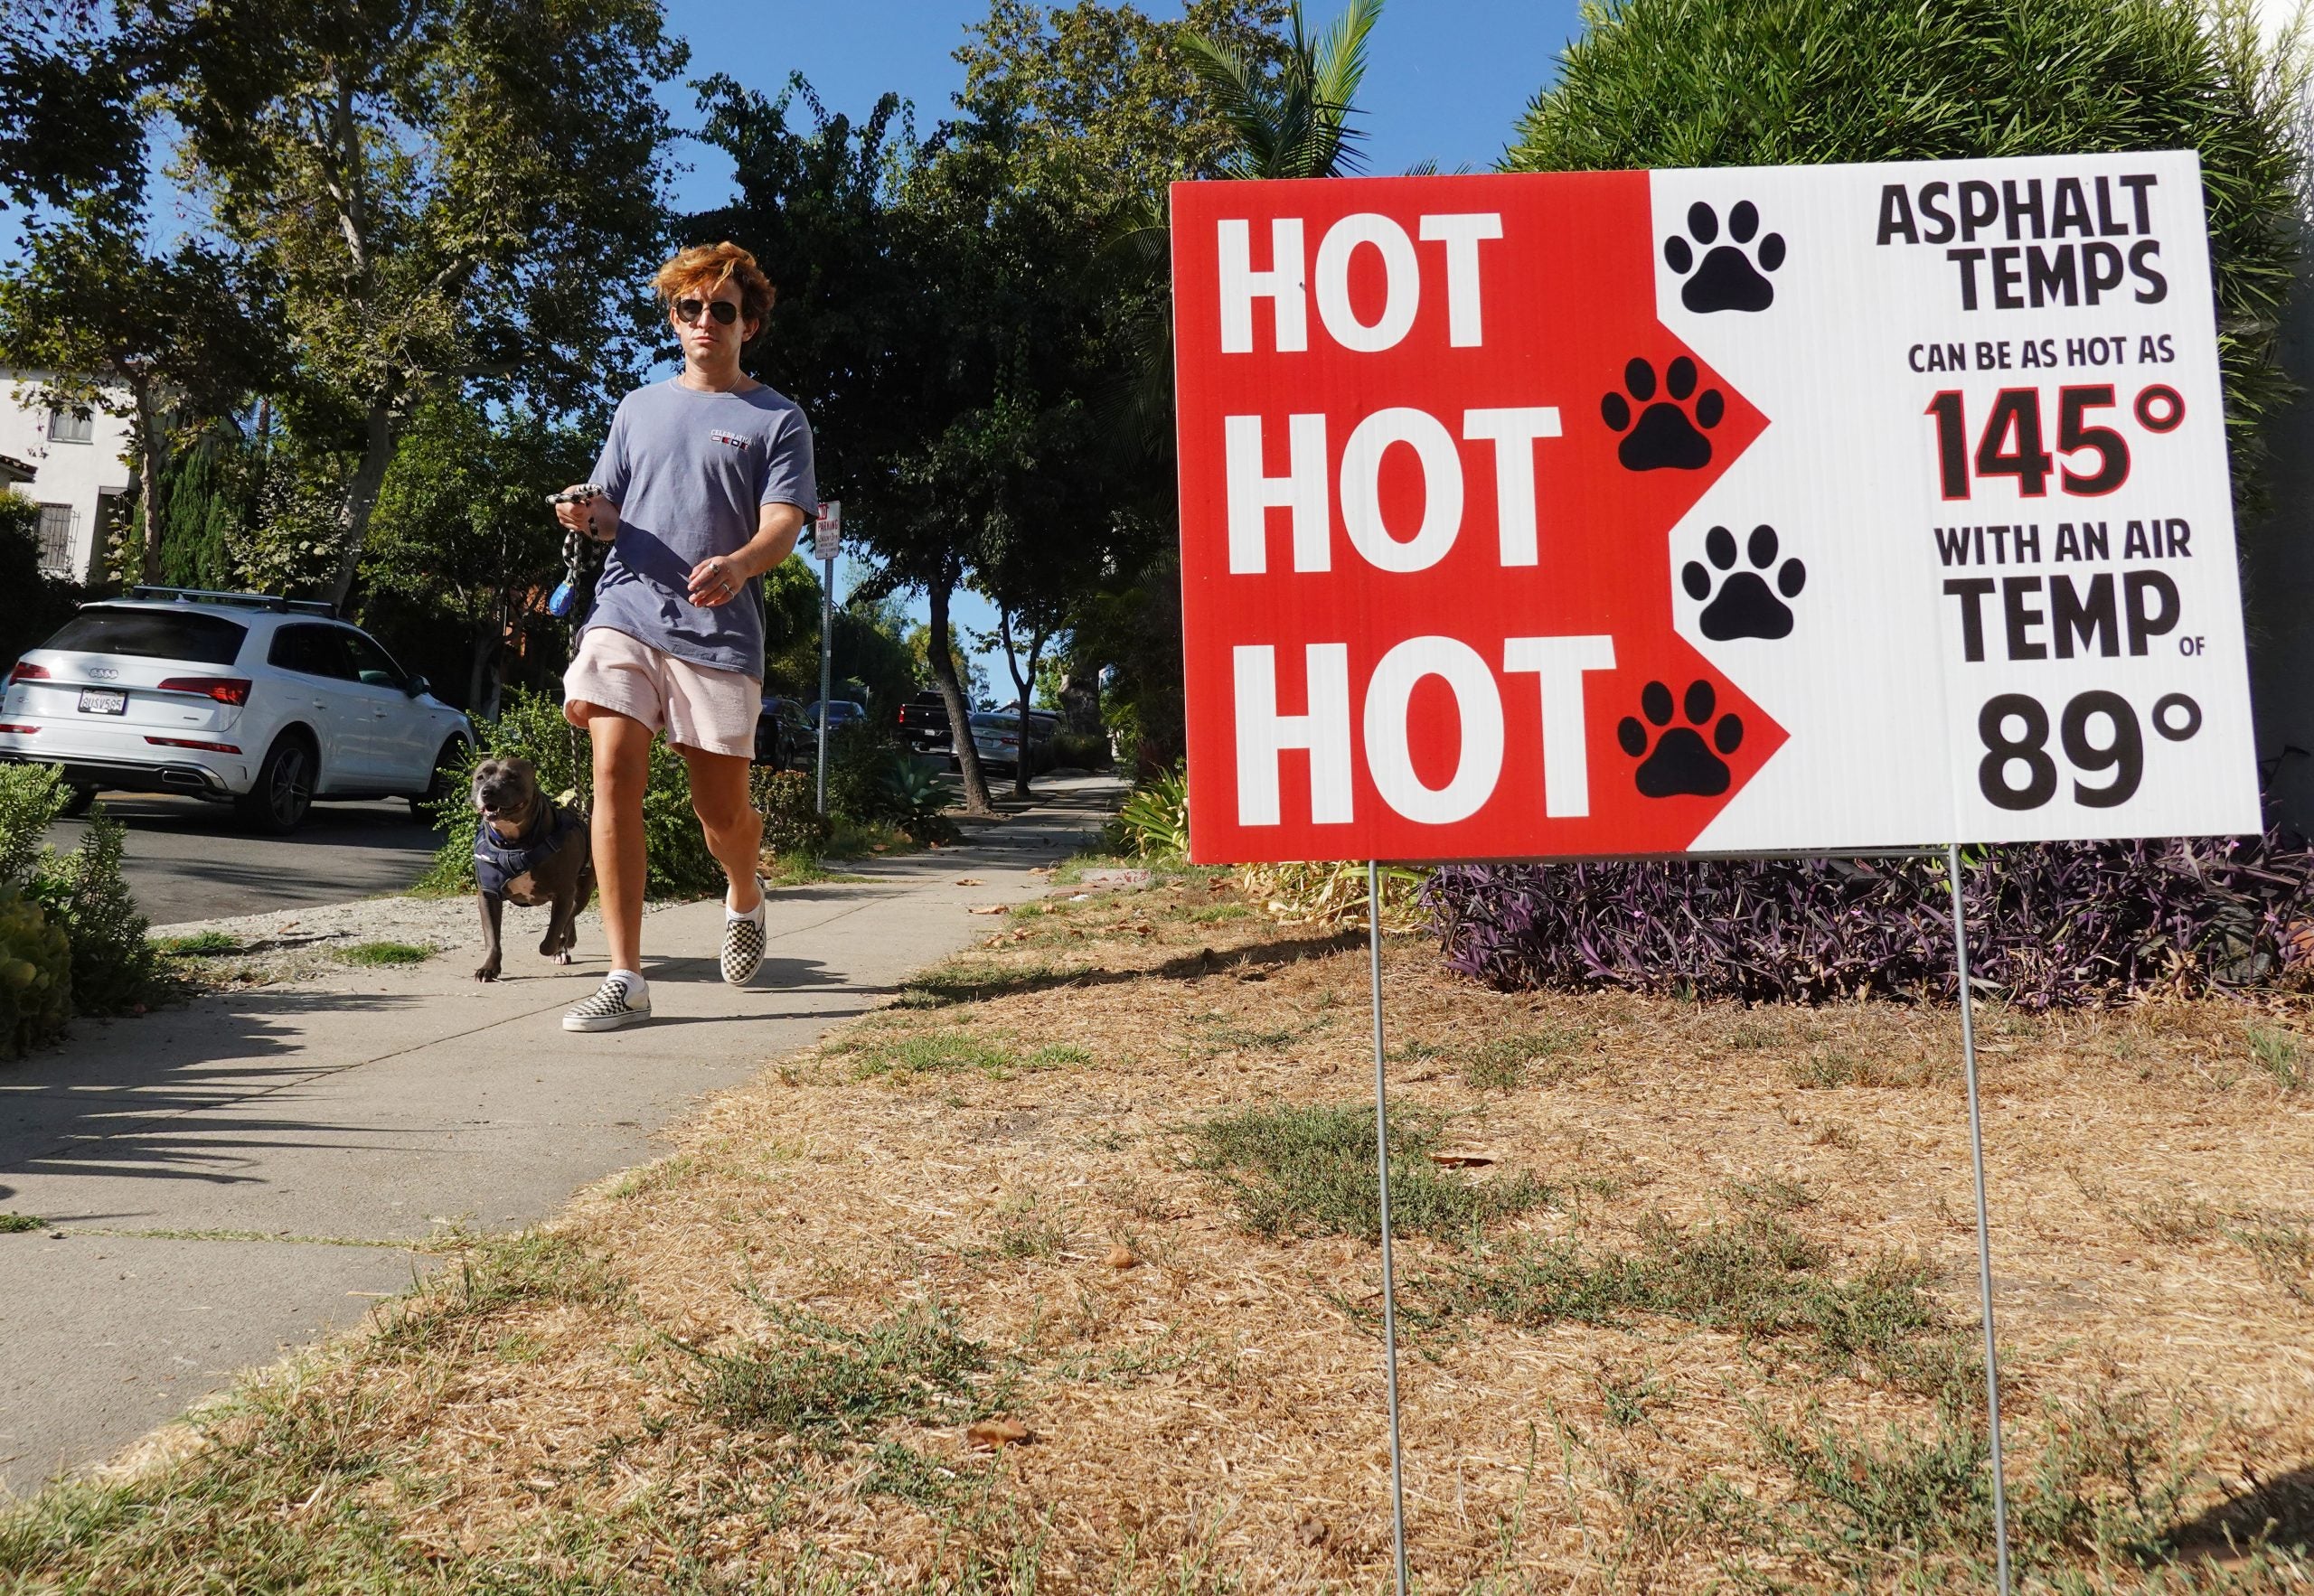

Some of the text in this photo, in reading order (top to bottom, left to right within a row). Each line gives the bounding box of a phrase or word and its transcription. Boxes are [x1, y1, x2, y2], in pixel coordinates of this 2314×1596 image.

[1877, 174, 2159, 246] ASPHALT
[1216, 212, 1504, 355] HOT
[1946, 239, 2168, 311] TEMPS
[1908, 333, 2175, 373] CAN BE AS HOT AS
[1924, 383, 2187, 502] 145°
[817, 520, 838, 532] PARKING
[1223, 406, 1564, 575] HOT
[1933, 518, 2193, 567] WITH AN AIR
[1943, 569, 2206, 662] TEMP OF
[1232, 634, 1617, 827] HOT
[1978, 690, 2204, 812] 89°
